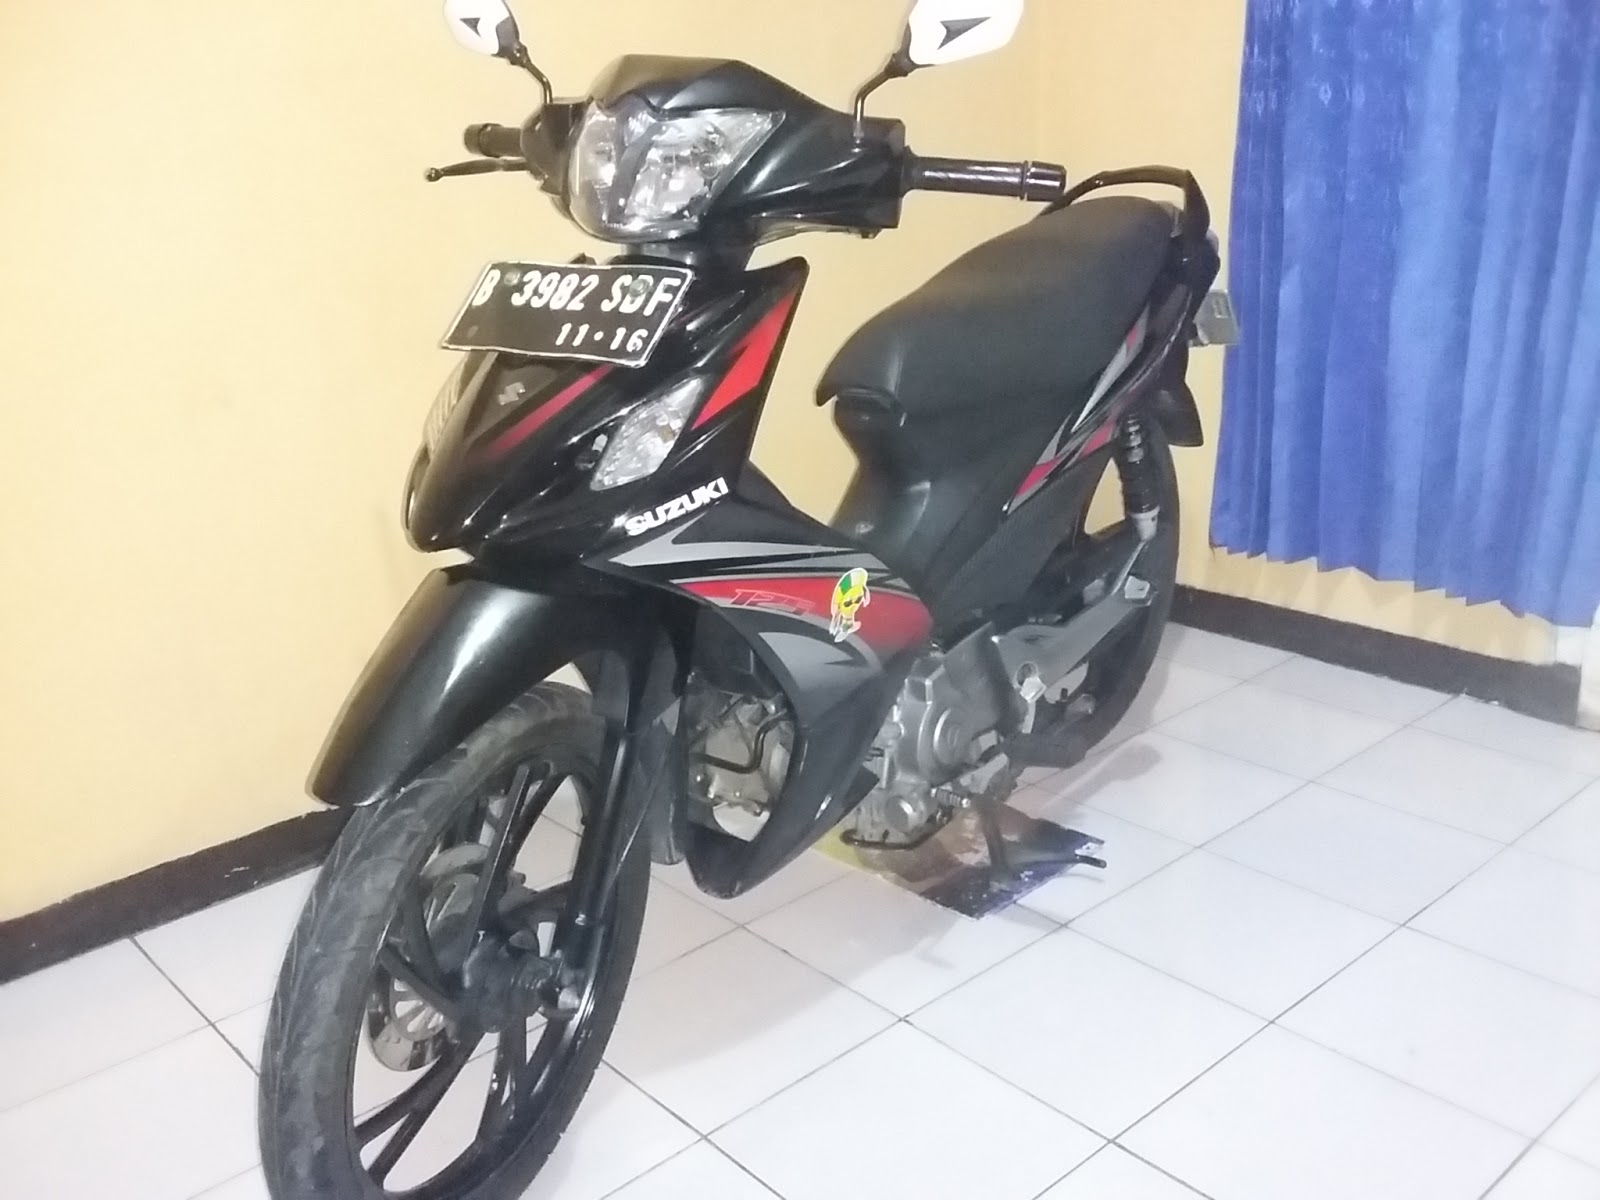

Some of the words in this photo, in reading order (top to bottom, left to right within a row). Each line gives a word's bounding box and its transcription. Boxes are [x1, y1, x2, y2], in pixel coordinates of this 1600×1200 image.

[472, 269, 501, 306] B
[511, 270, 599, 310] 3982
[624, 476, 729, 537] SUZUKI
